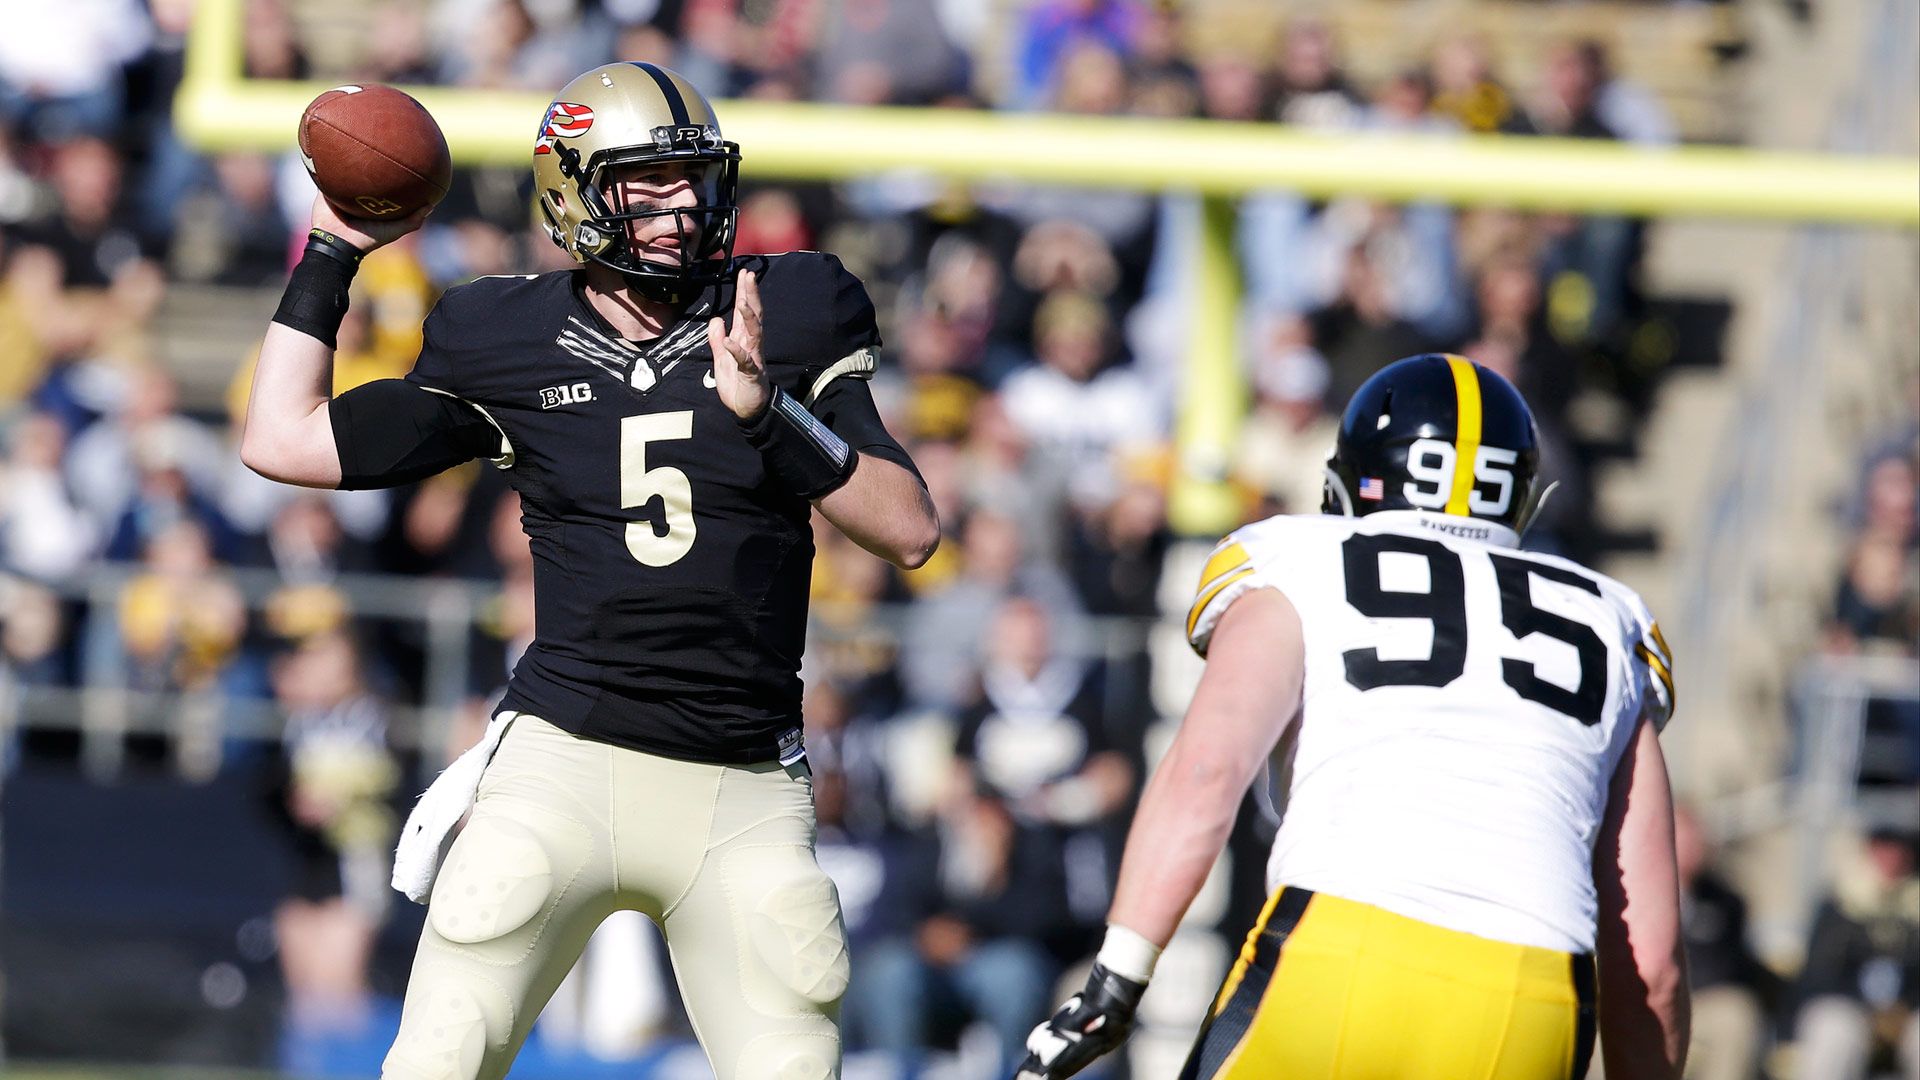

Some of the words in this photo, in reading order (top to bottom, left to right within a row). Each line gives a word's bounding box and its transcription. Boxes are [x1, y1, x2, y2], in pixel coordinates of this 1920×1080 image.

[535, 102, 594, 155] P
[676, 128, 700, 142] P
[620, 410, 697, 567] 5
[1403, 438, 1518, 516] 95
[1342, 533, 1608, 727] 95
